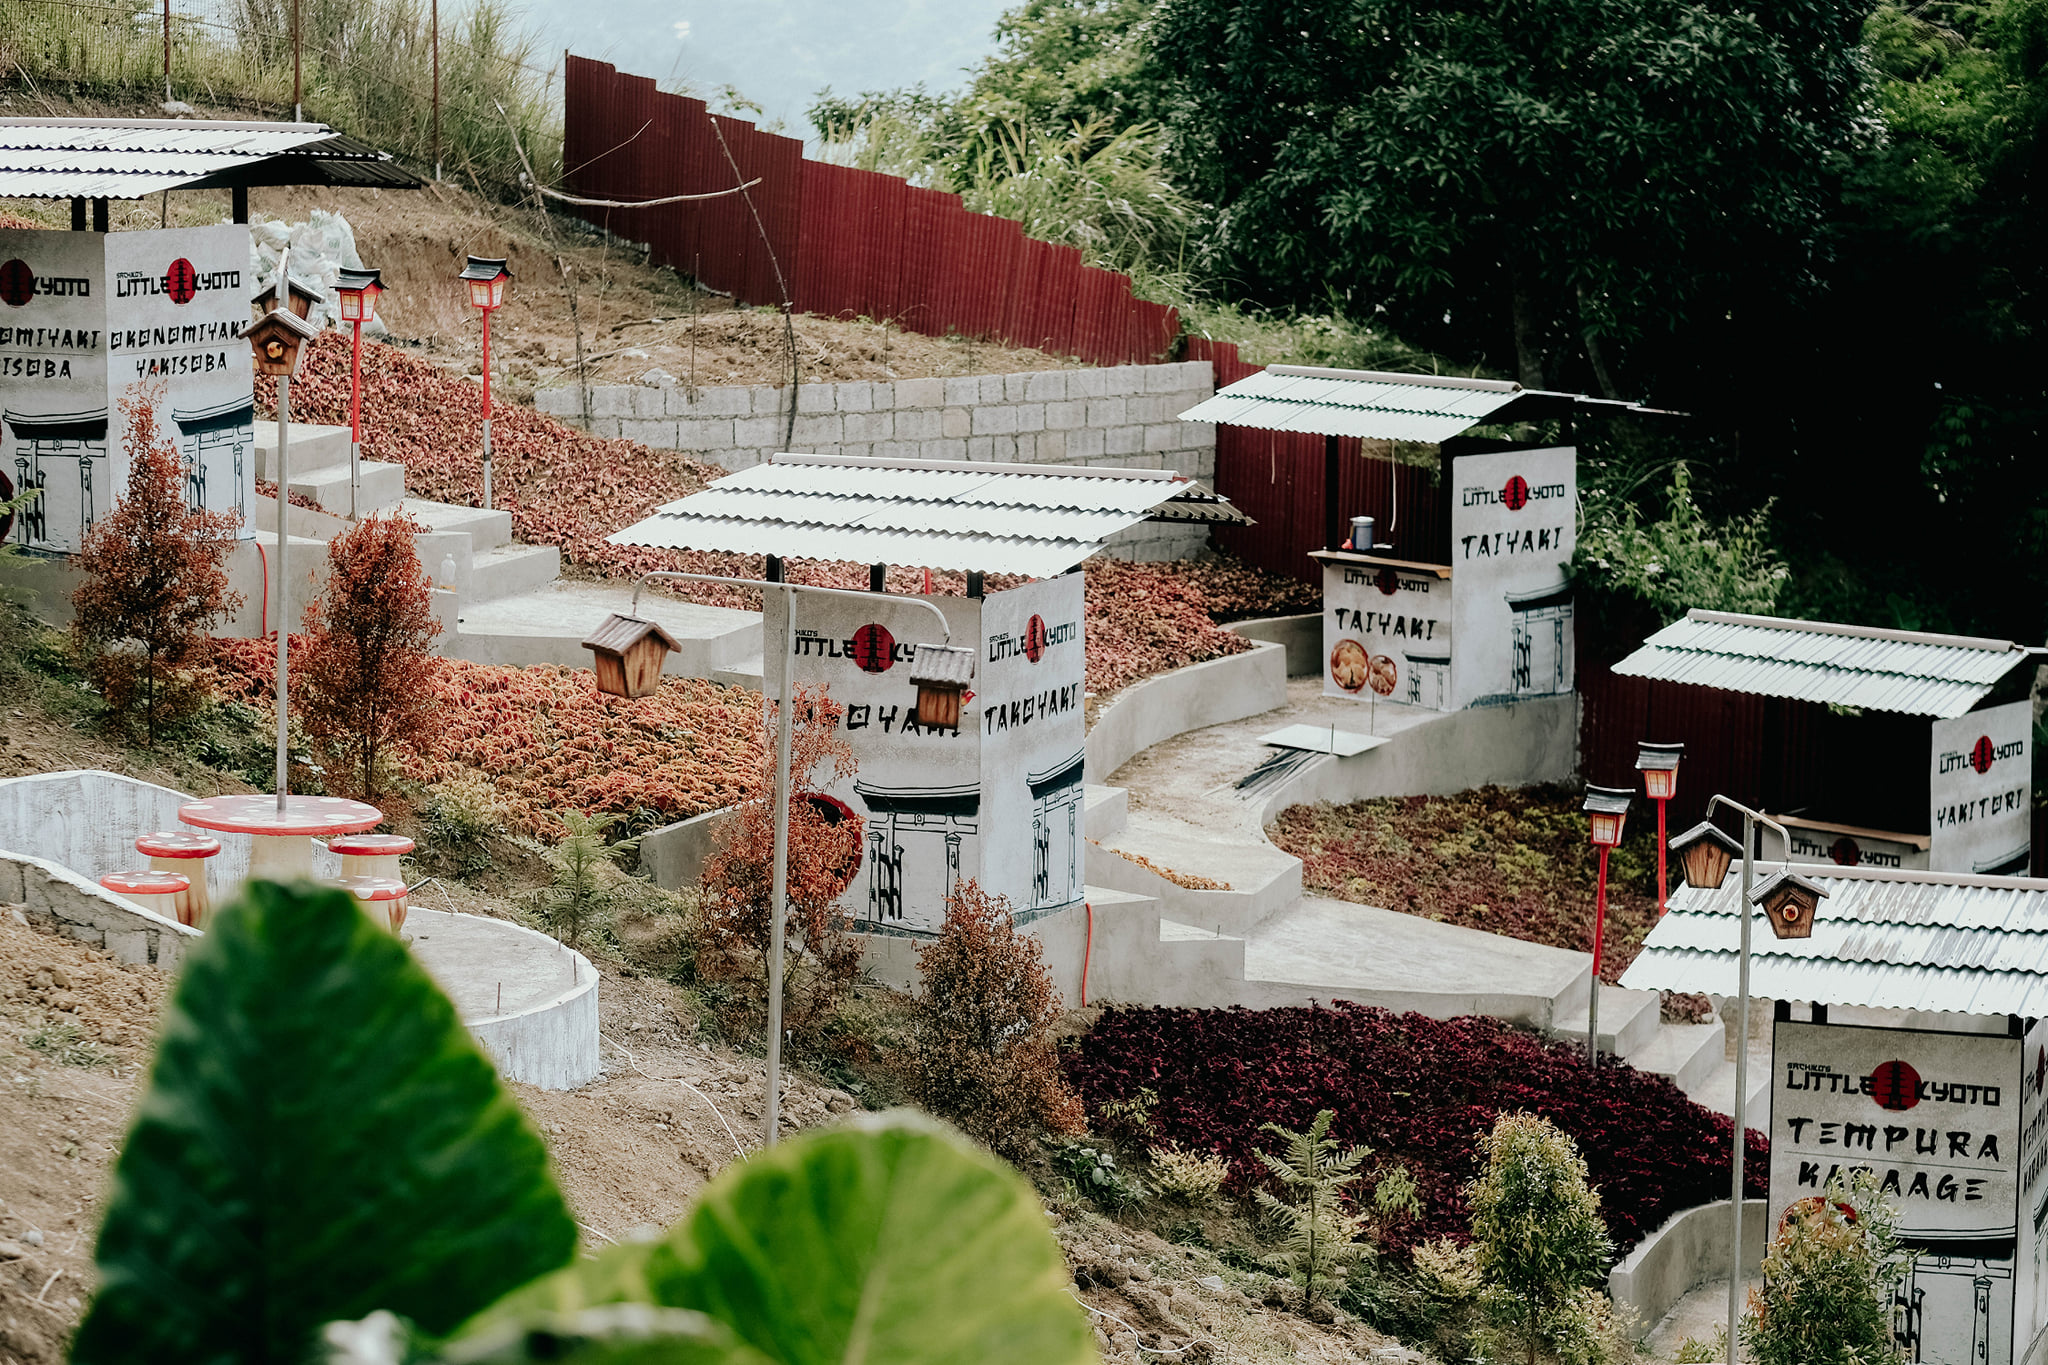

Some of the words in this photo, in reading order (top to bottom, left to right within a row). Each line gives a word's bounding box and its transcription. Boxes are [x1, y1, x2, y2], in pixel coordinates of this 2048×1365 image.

[28, 277, 90, 296] KYOTO
[117, 276, 171, 297] LITTLE
[191, 271, 240, 291] KYOTO
[136, 352, 227, 378] YAKISOBA
[1463, 489, 1507, 506] LITTLE
[1524, 484, 1564, 501] KYOTO
[1461, 527, 1563, 559] TAIYAKI
[1344, 571, 1381, 587] LITTLE
[1395, 578, 1429, 593] KYOTO
[1334, 608, 1437, 640] TAIYAKI
[795, 637, 858, 660] ITTLE
[989, 634, 1028, 662] LITTLE
[1042, 621, 1076, 647] KYOTO
[984, 682, 1078, 736] TAKOYAKI
[1940, 752, 1976, 774] LITTLE
[1990, 741, 2023, 762] KYOTO
[1937, 788, 2023, 829] YAKITORI
[1858, 850, 1901, 867] KYOTO
[1787, 1070, 1878, 1097] LITTLE
[1914, 1080, 2001, 1107] KYOTO
[1787, 1117, 2000, 1162] TEMPURA
